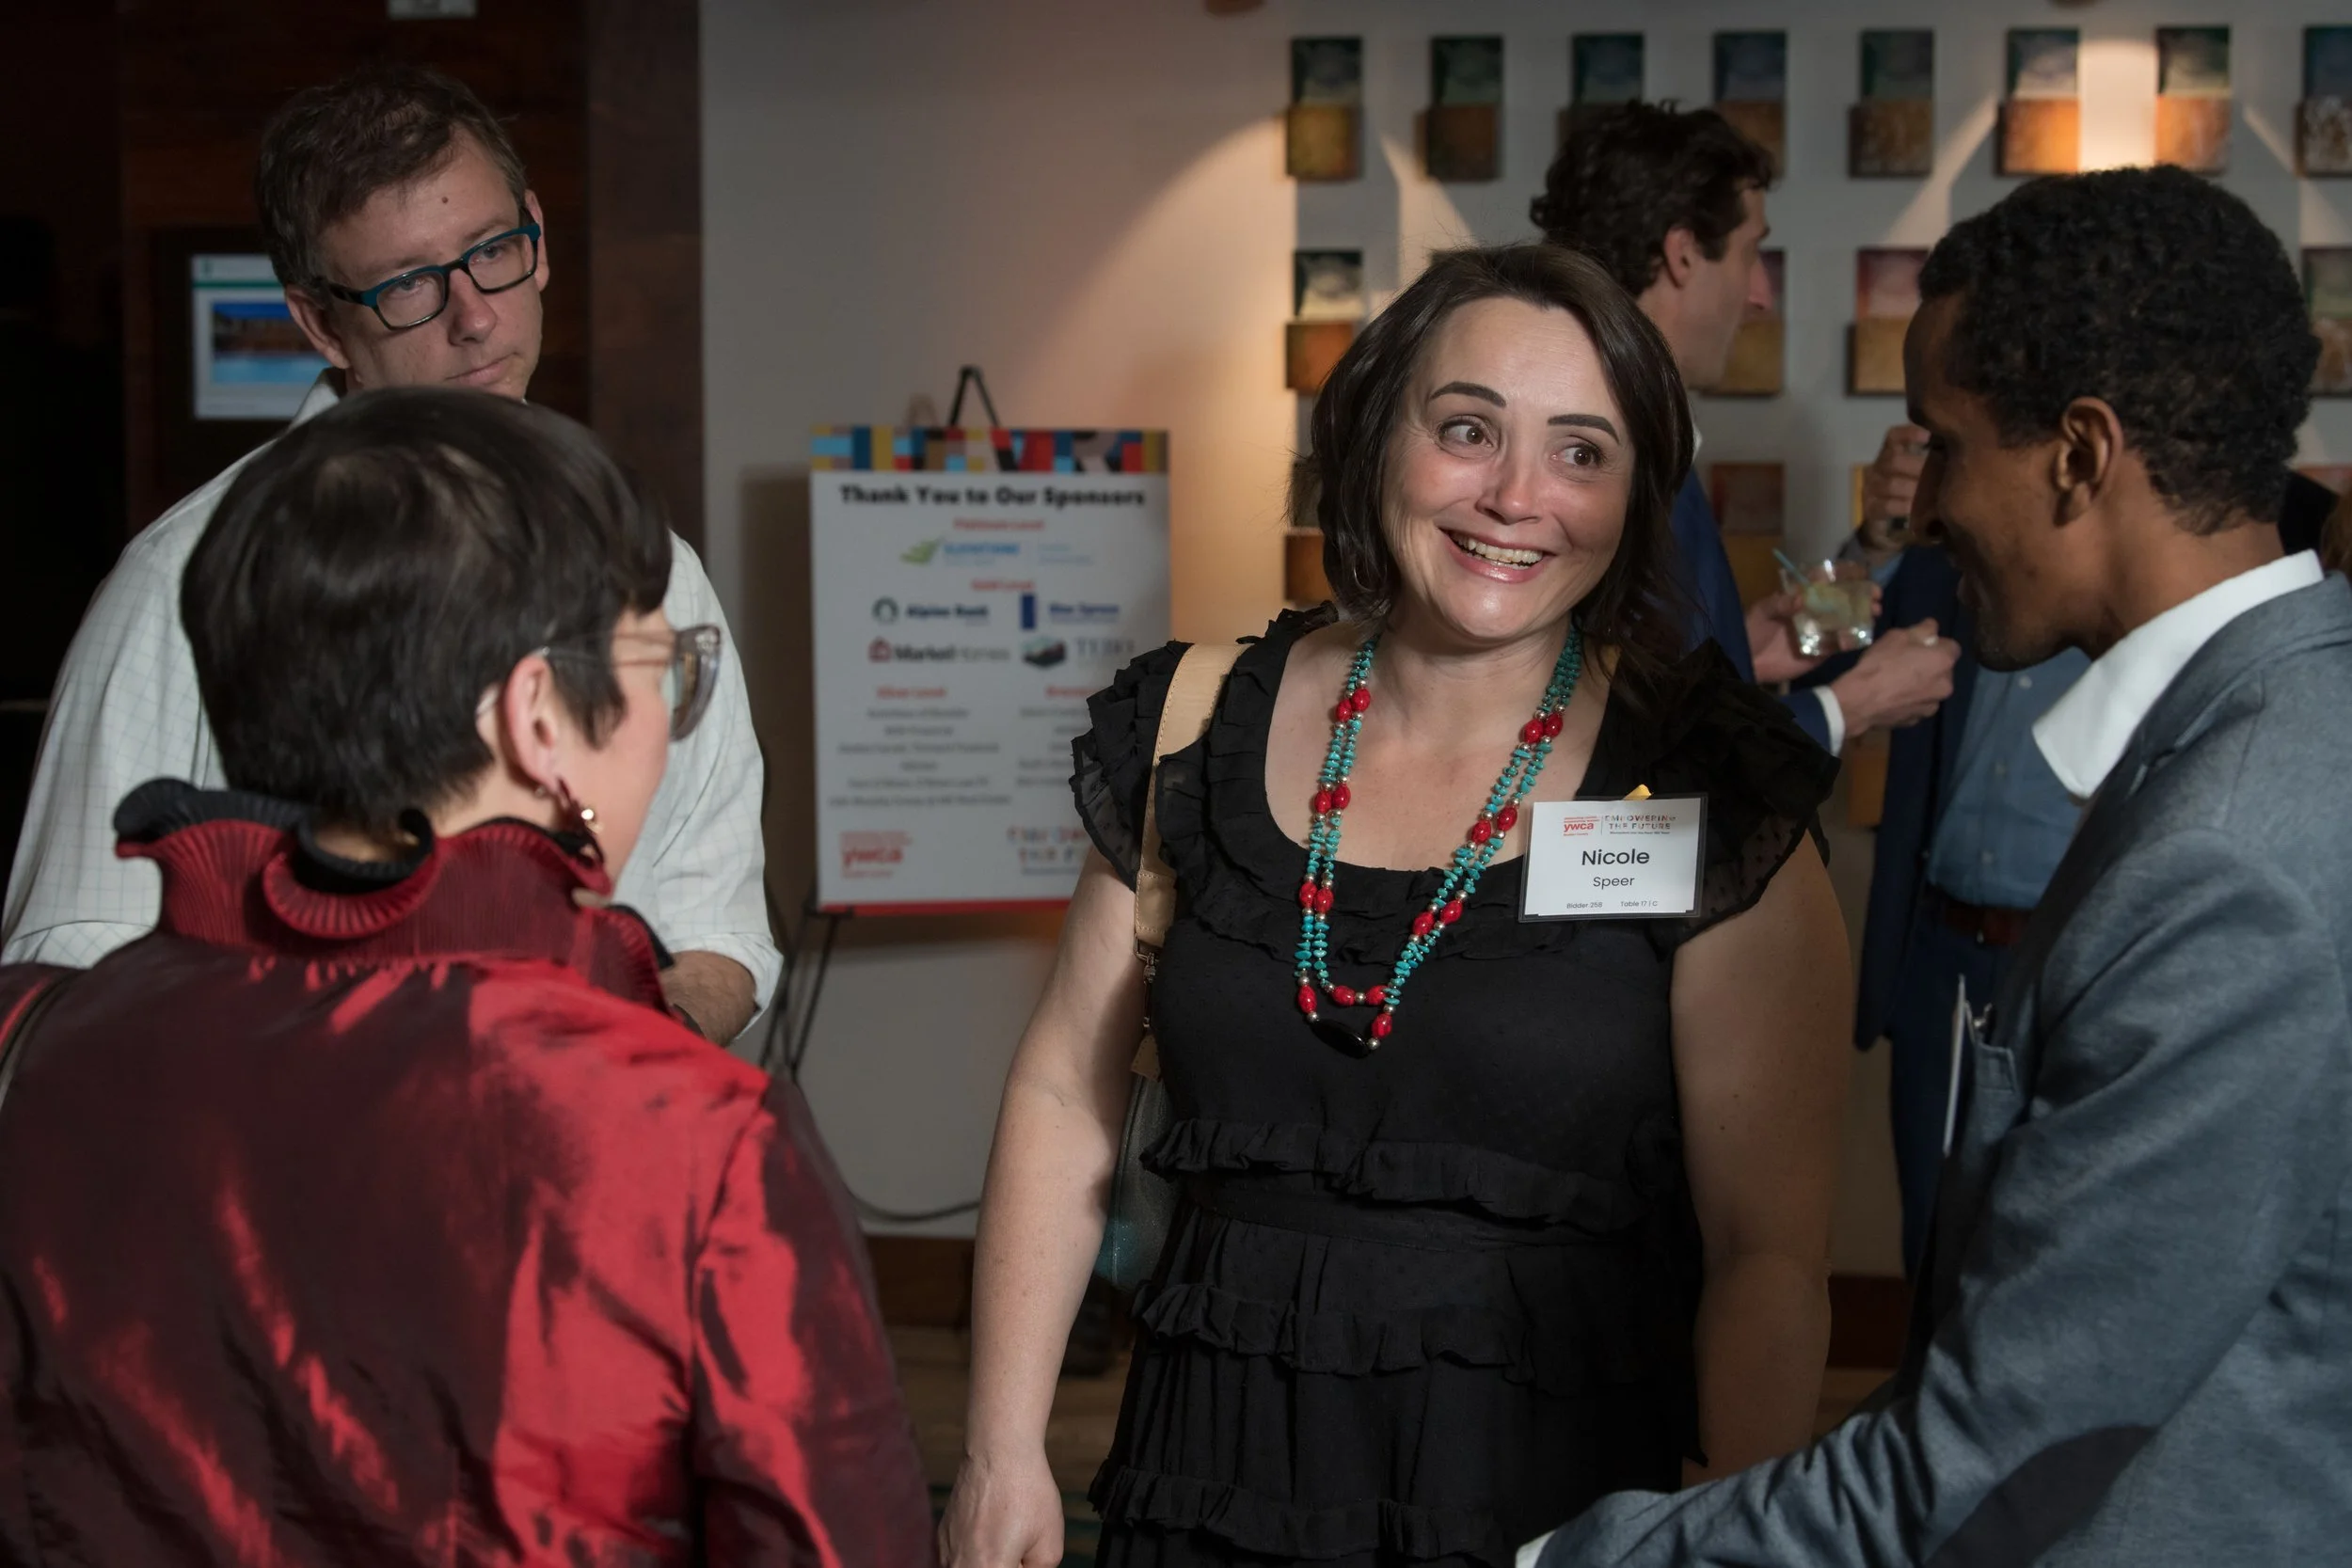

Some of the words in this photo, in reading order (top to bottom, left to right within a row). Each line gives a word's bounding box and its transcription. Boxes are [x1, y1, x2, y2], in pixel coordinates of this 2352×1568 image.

[840, 484, 909, 504] Thank
[916, 485, 959, 504] You
[965, 487, 988, 504] to
[996, 486, 1036, 503] Our
[1044, 486, 1145, 509] Sponsors
[1564, 822, 1594, 832] ywca
[1581, 848, 1650, 866] Nicole
[1593, 877, 1635, 890] Speer
